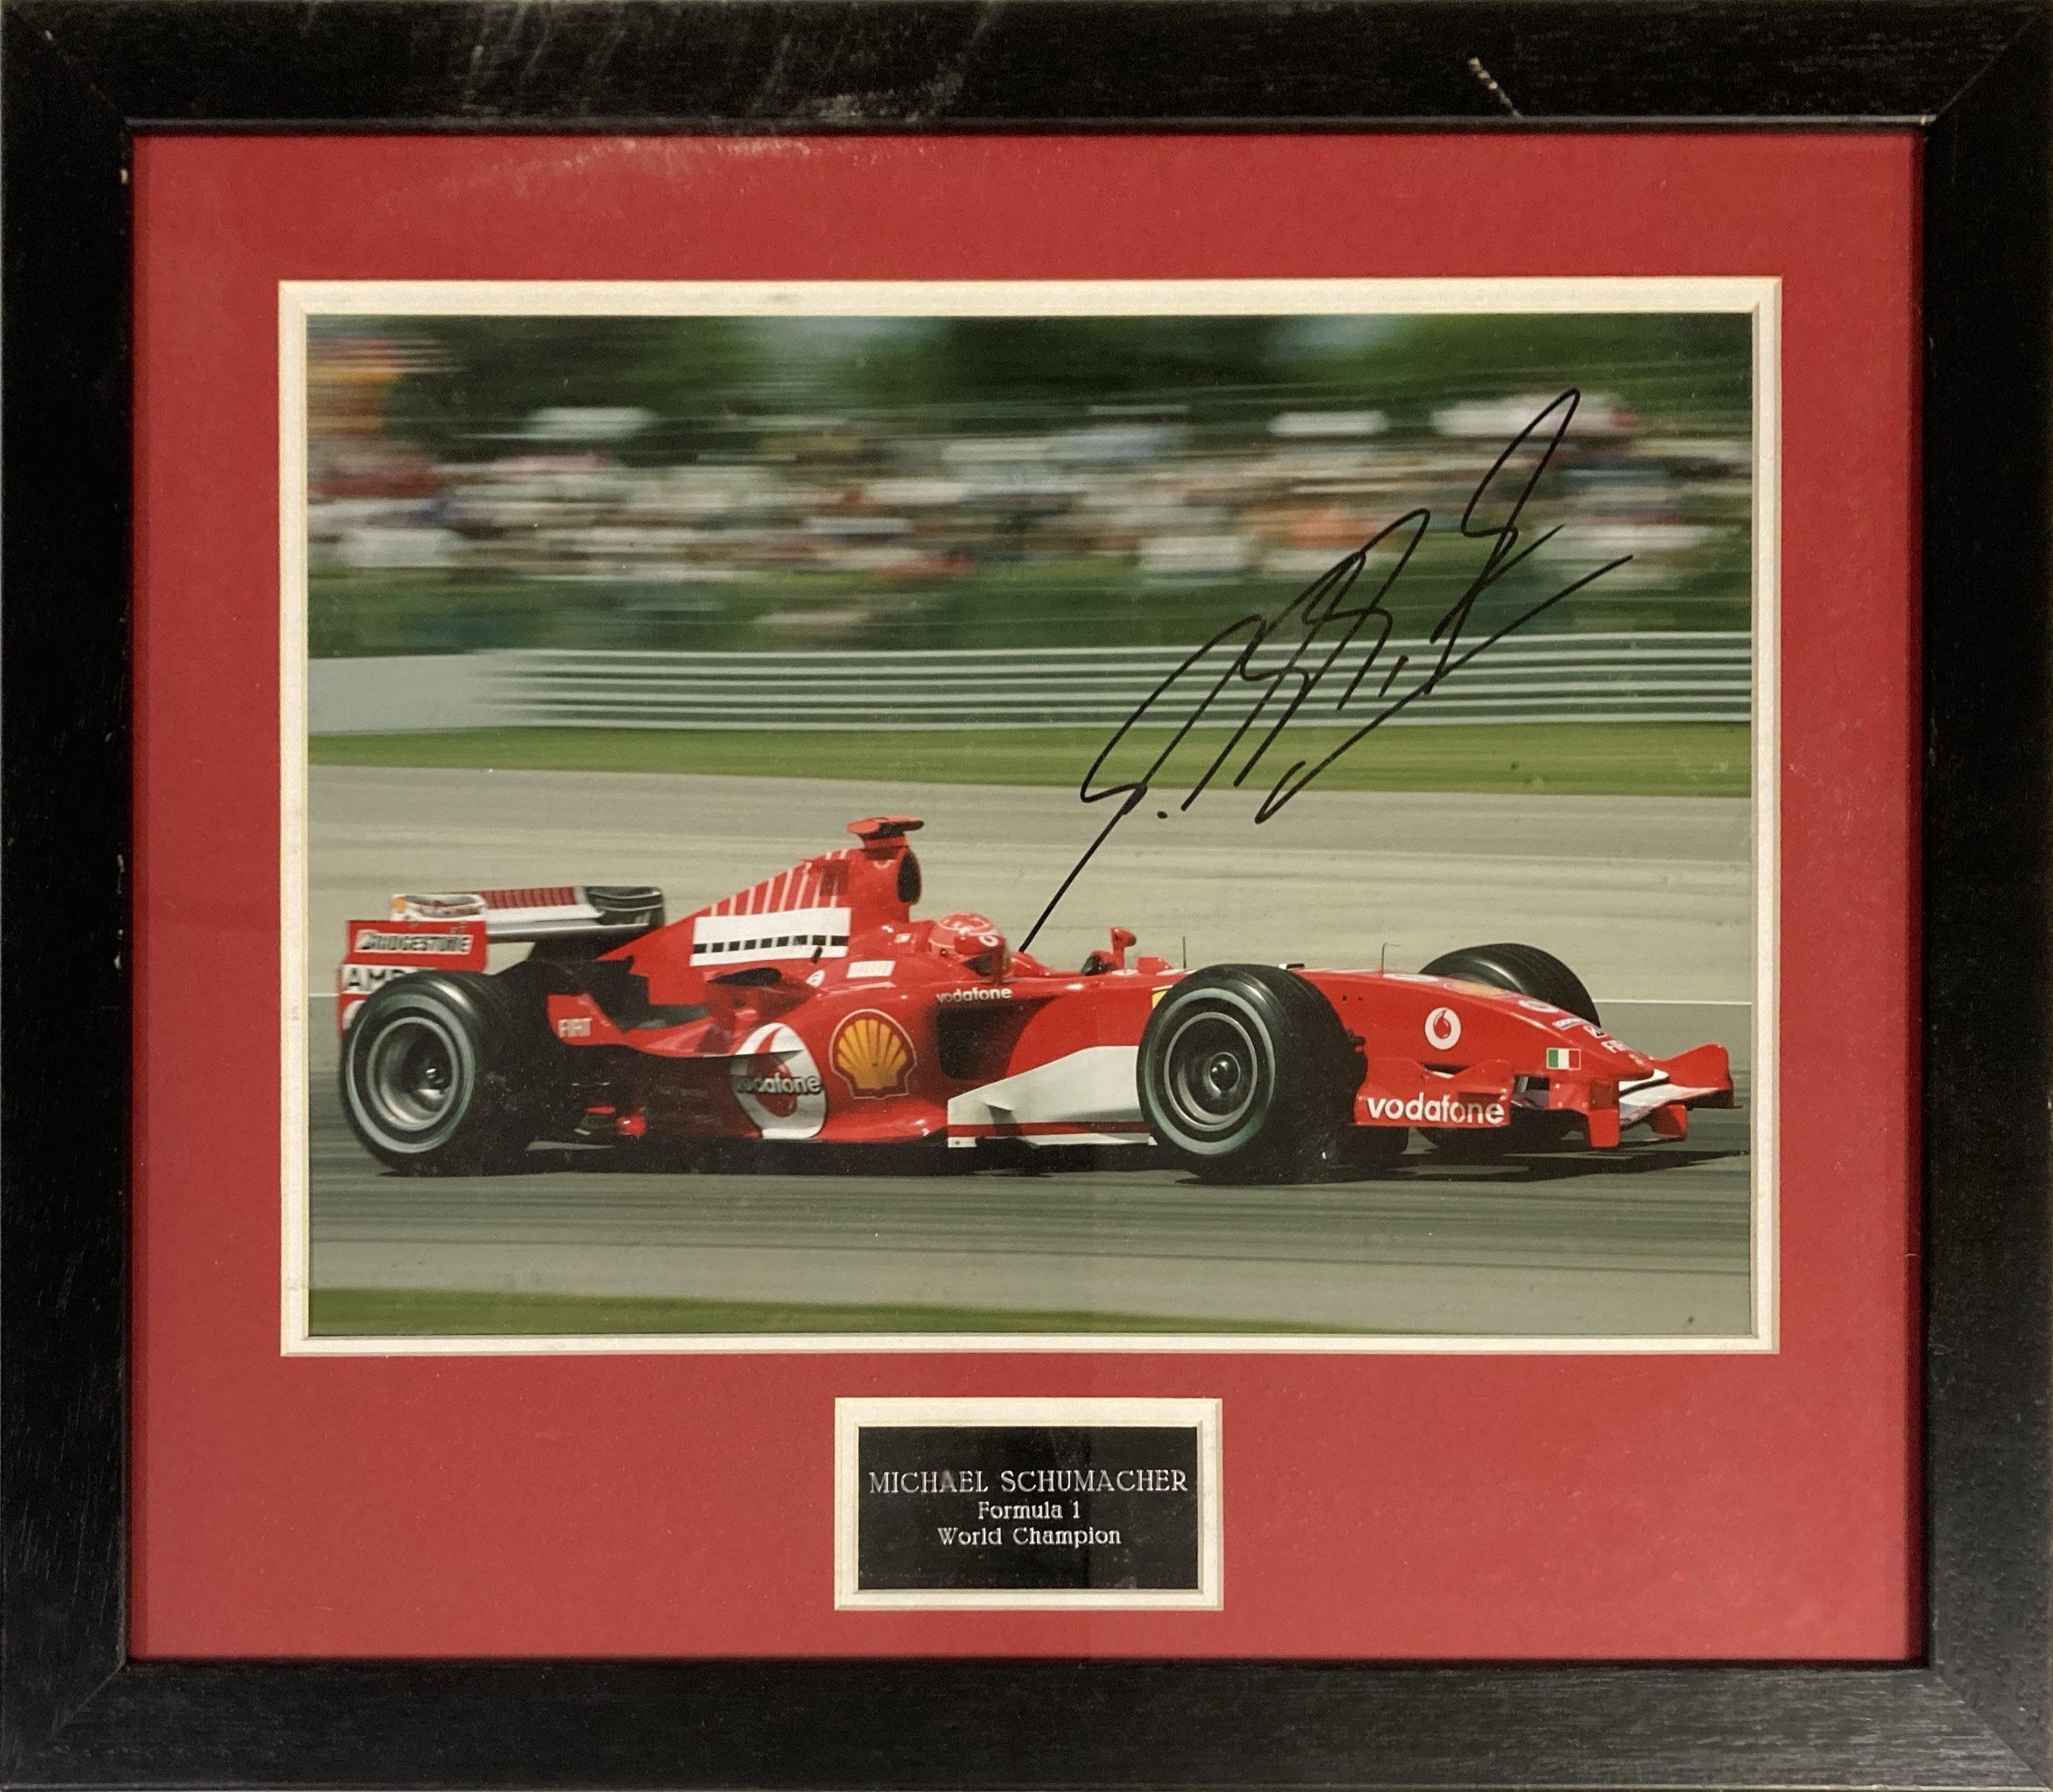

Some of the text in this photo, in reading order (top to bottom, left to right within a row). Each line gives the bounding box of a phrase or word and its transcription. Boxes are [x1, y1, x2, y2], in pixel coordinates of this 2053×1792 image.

[936, 987, 1012, 1004] vodafone
[1367, 1092, 1505, 1125] vodafone
[869, 1469, 1188, 1494] MICHAEL SCHUMACHER
[977, 1501, 1082, 1520] Formula 1
[936, 1527, 1122, 1548] World Champion
